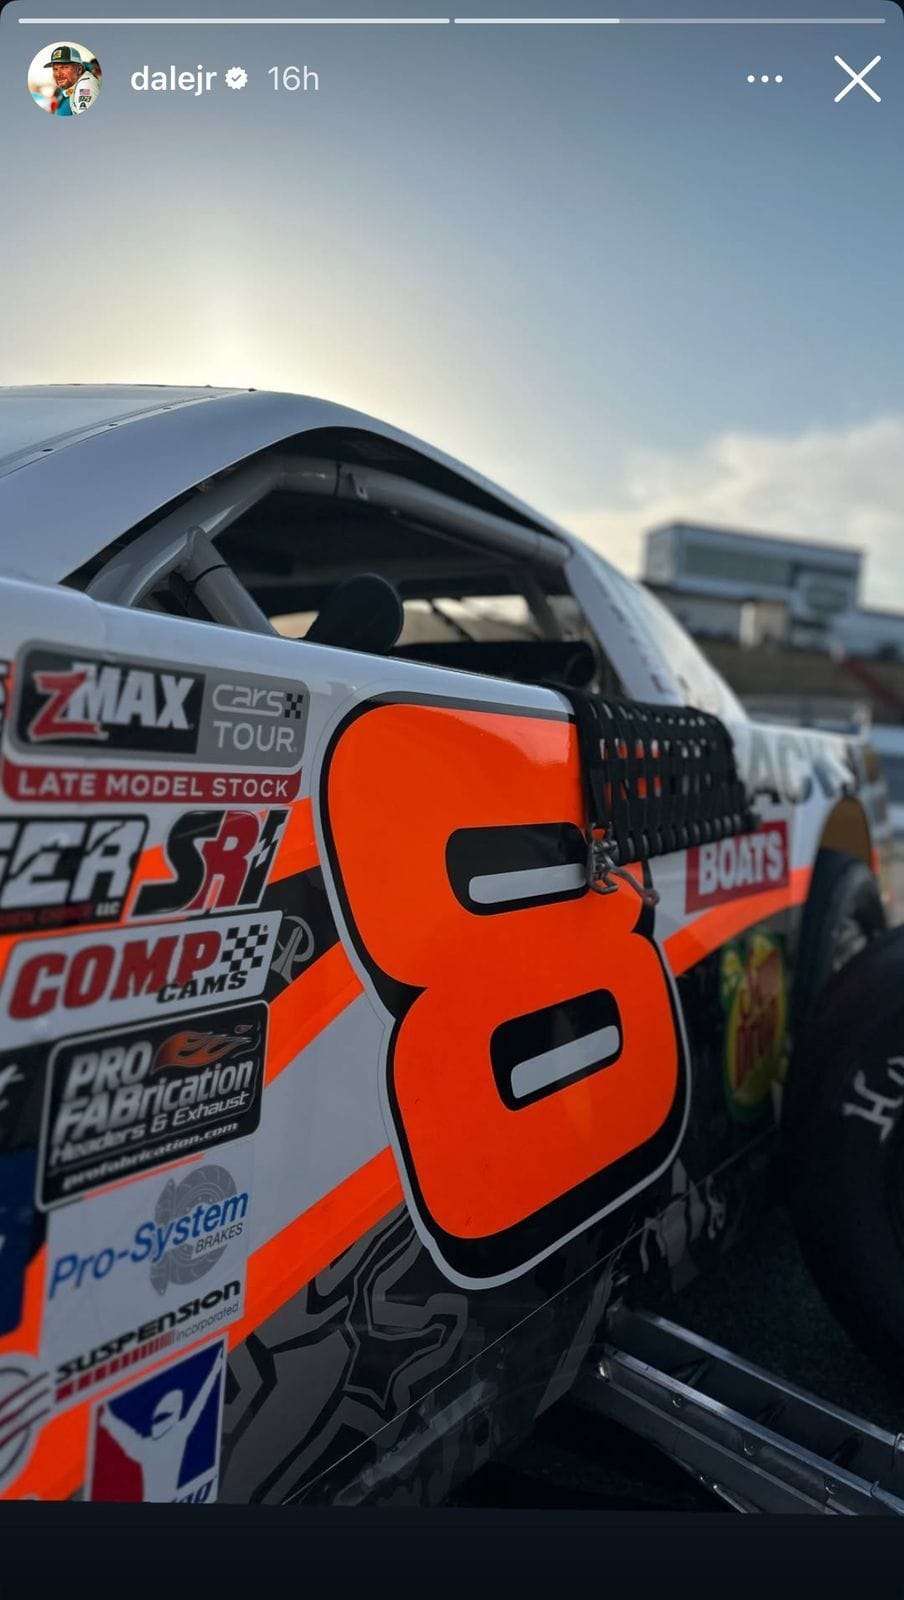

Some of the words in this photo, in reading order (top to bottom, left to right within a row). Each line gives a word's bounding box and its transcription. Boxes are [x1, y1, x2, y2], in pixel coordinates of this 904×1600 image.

[212, 720, 295, 753] TOUR
[18, 770, 96, 796] LATE
[105, 774, 203, 797] MODEL
[211, 777, 289, 798] STOCK
[698, 830, 782, 895] BOATS
[8, 930, 222, 1021] COMP
[156, 970, 249, 1003] CAMS
[319, 692, 692, 1290] 8
[50, 1060, 254, 1145] FABrication
[65, 1041, 153, 1103] PRO
[49, 1123, 146, 1166] Headers
[172, 1091, 250, 1127] Exhaust
[61, 1122, 239, 1191] profabrication.com
[48, 1192, 249, 1301] Pro-System
[195, 1222, 244, 1254] BRAKES
[175, 1302, 240, 1342] incorporated
